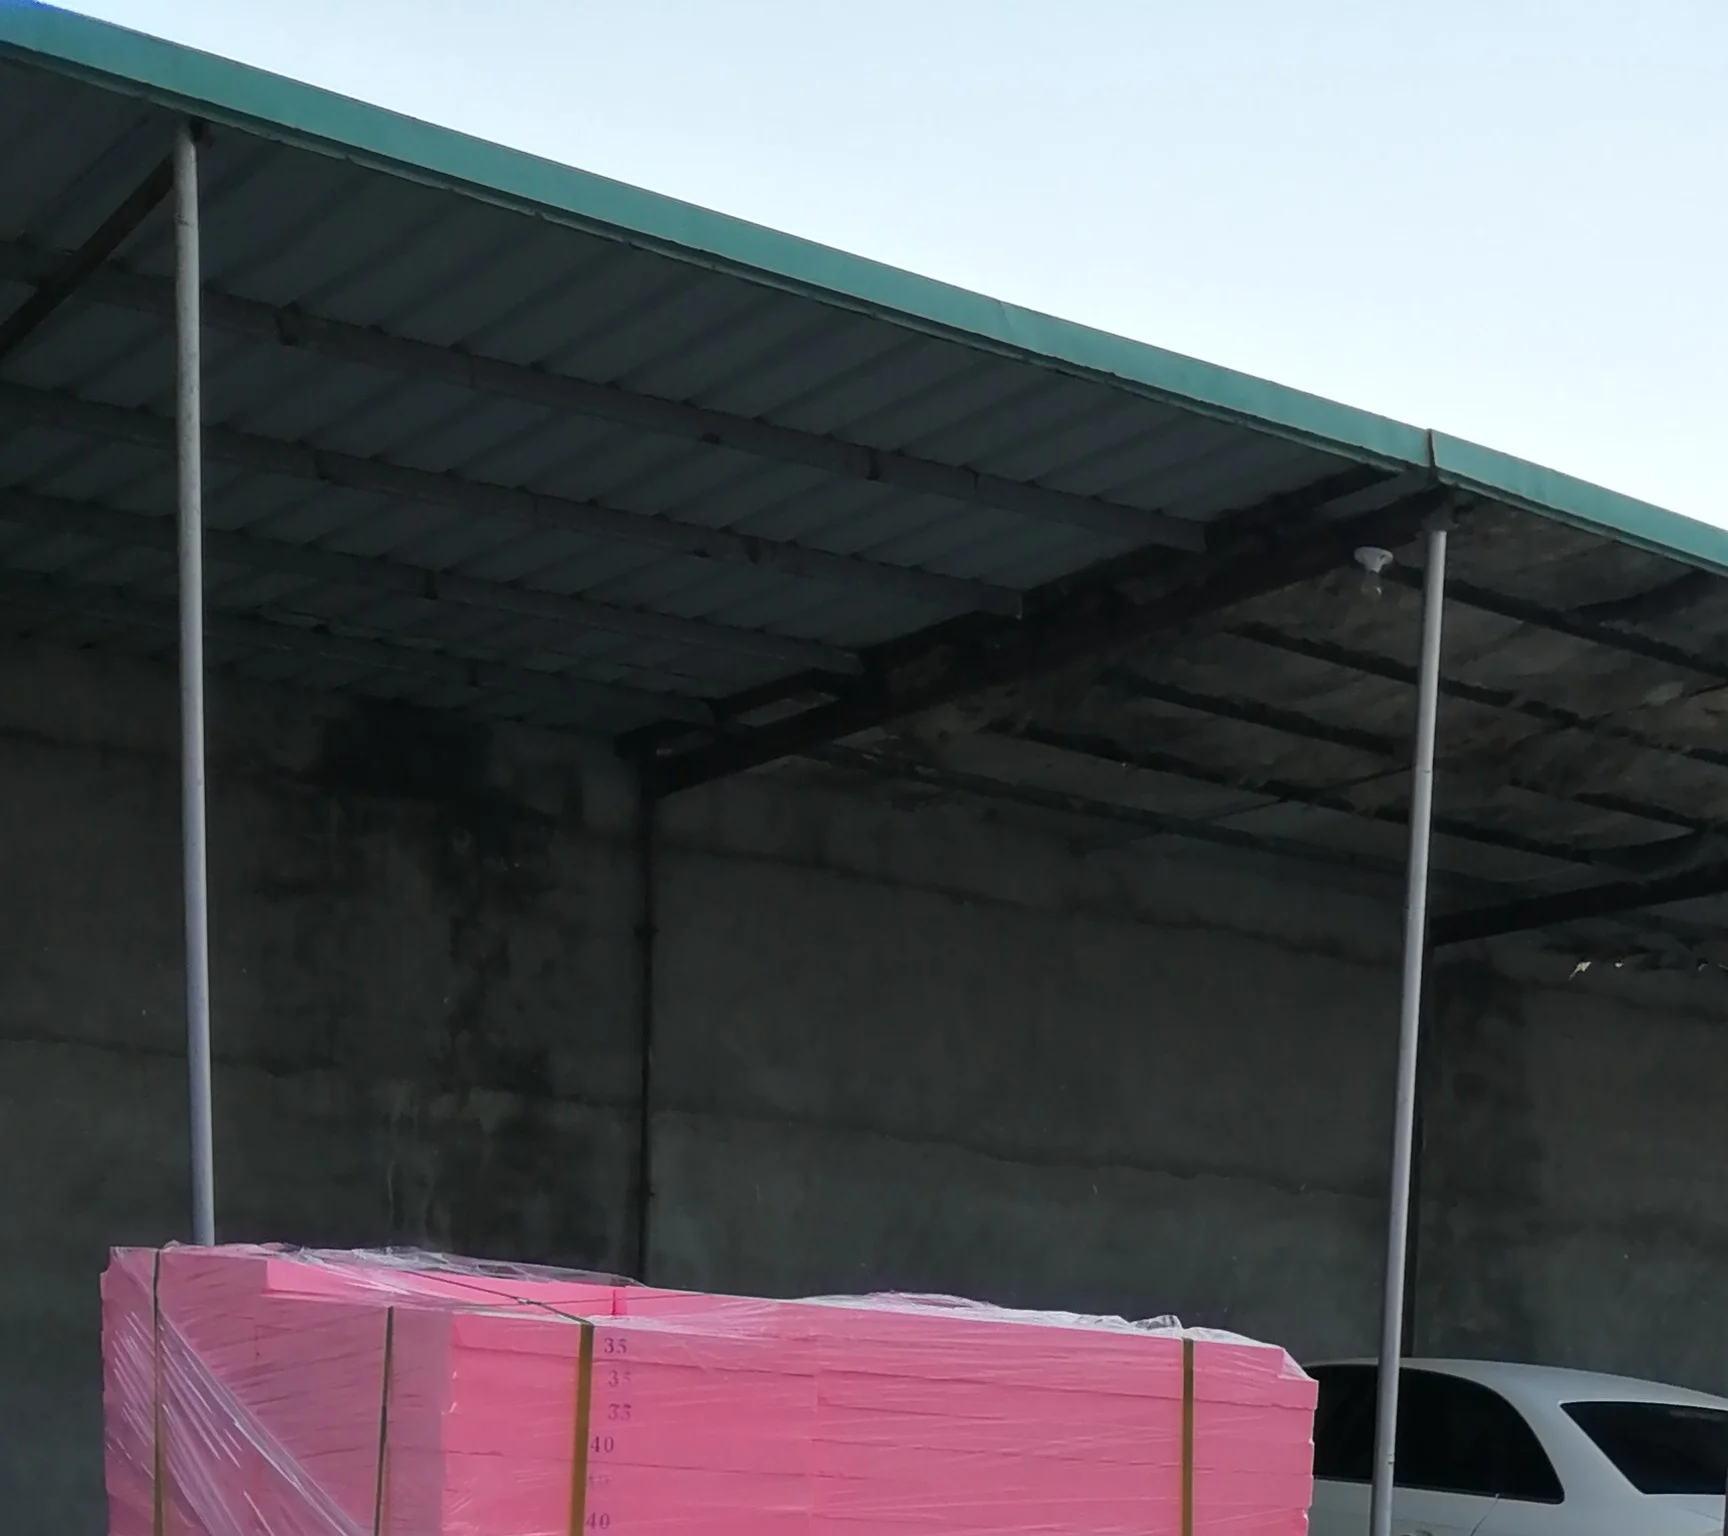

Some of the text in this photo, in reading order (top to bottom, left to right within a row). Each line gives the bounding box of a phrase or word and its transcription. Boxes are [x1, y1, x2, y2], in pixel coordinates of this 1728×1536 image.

[604, 1337, 627, 1354] 35
[590, 1436, 614, 1452] 40
[585, 1512, 610, 1529] 40
